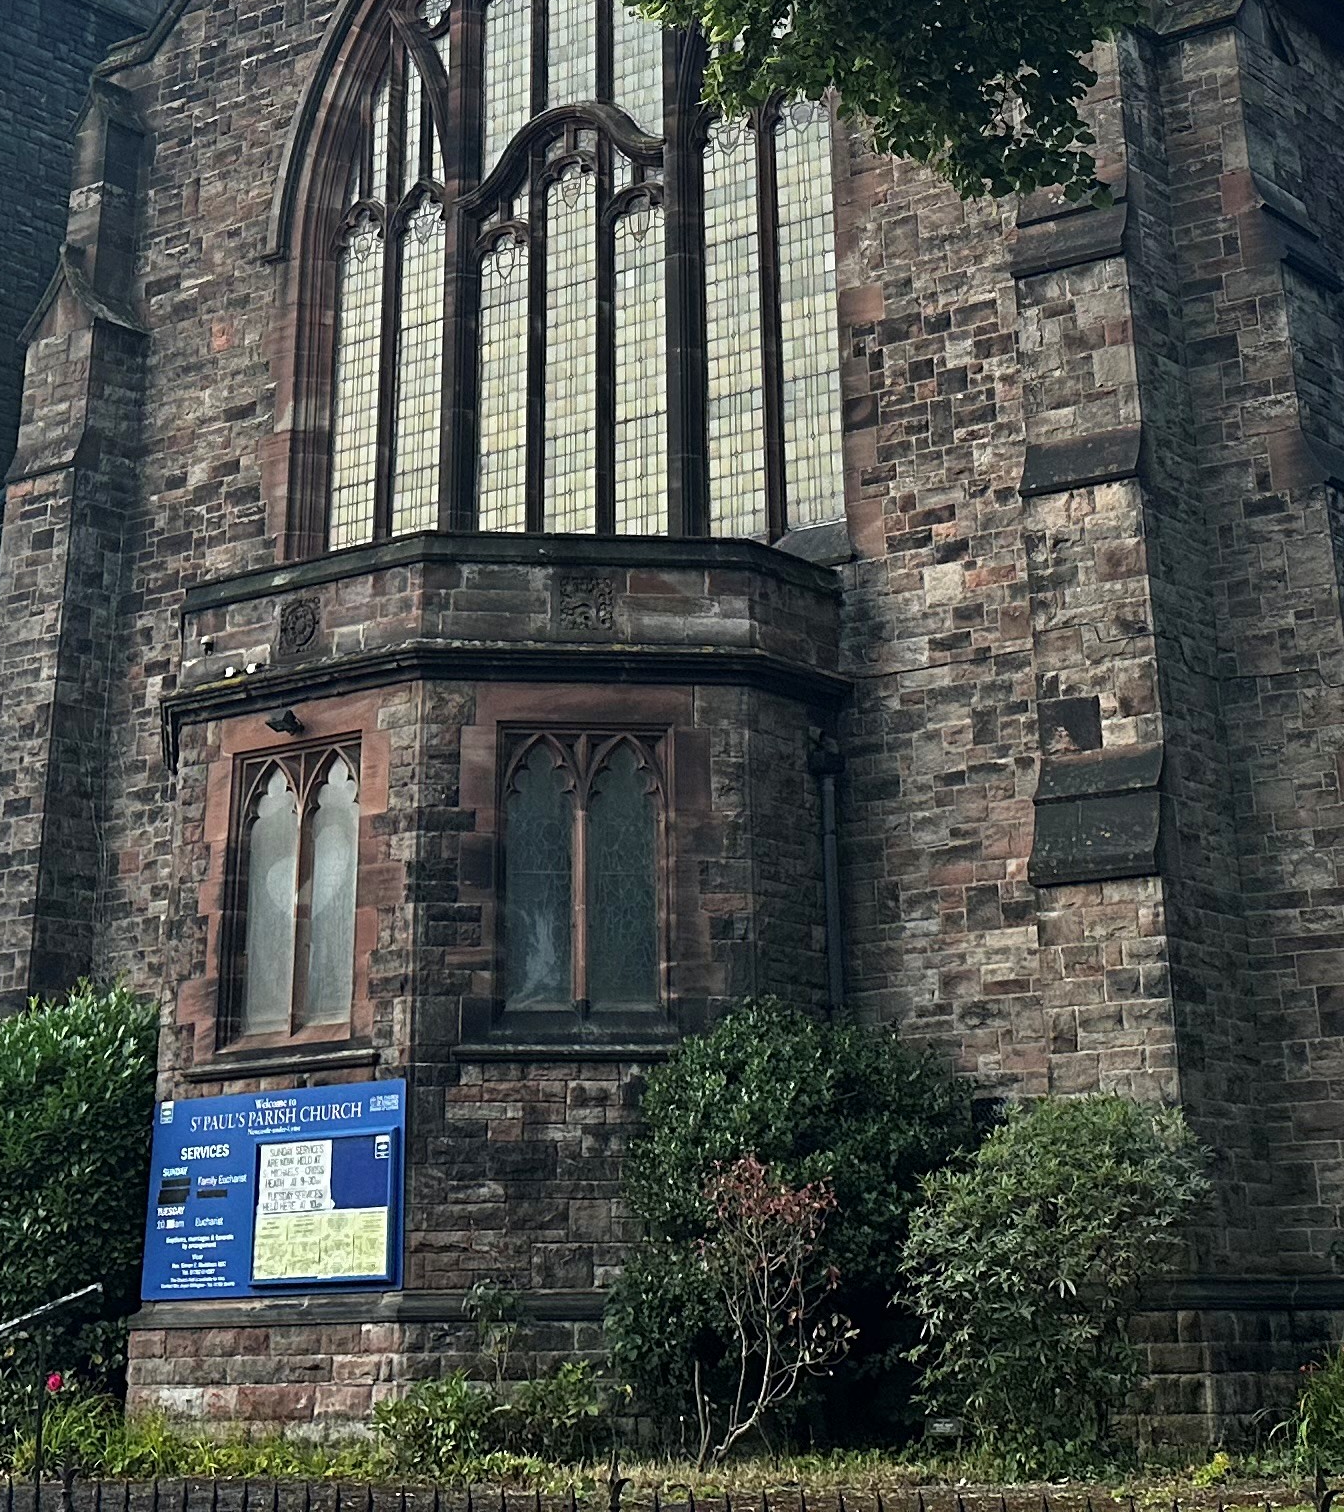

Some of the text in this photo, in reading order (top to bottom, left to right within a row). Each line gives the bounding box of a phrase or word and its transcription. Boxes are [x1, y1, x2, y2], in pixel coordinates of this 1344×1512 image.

[255, 1098, 297, 1108] Welcome to
[203, 1111, 246, 1131] PAUL'S
[248, 1107, 297, 1127] PARISH
[300, 1102, 362, 1123] CHURCH
[181, 1144, 230, 1160] SERVICES
[270, 1144, 325, 1157] SUNDAY SERVICES
[267, 1158, 280, 1167] ARE
[163, 1167, 188, 1176] SUNDAY
[198, 1174, 247, 1186] Family Eucharist
[157, 1207, 185, 1216] TUESDAY
[195, 1217, 223, 1226] Eucharist
